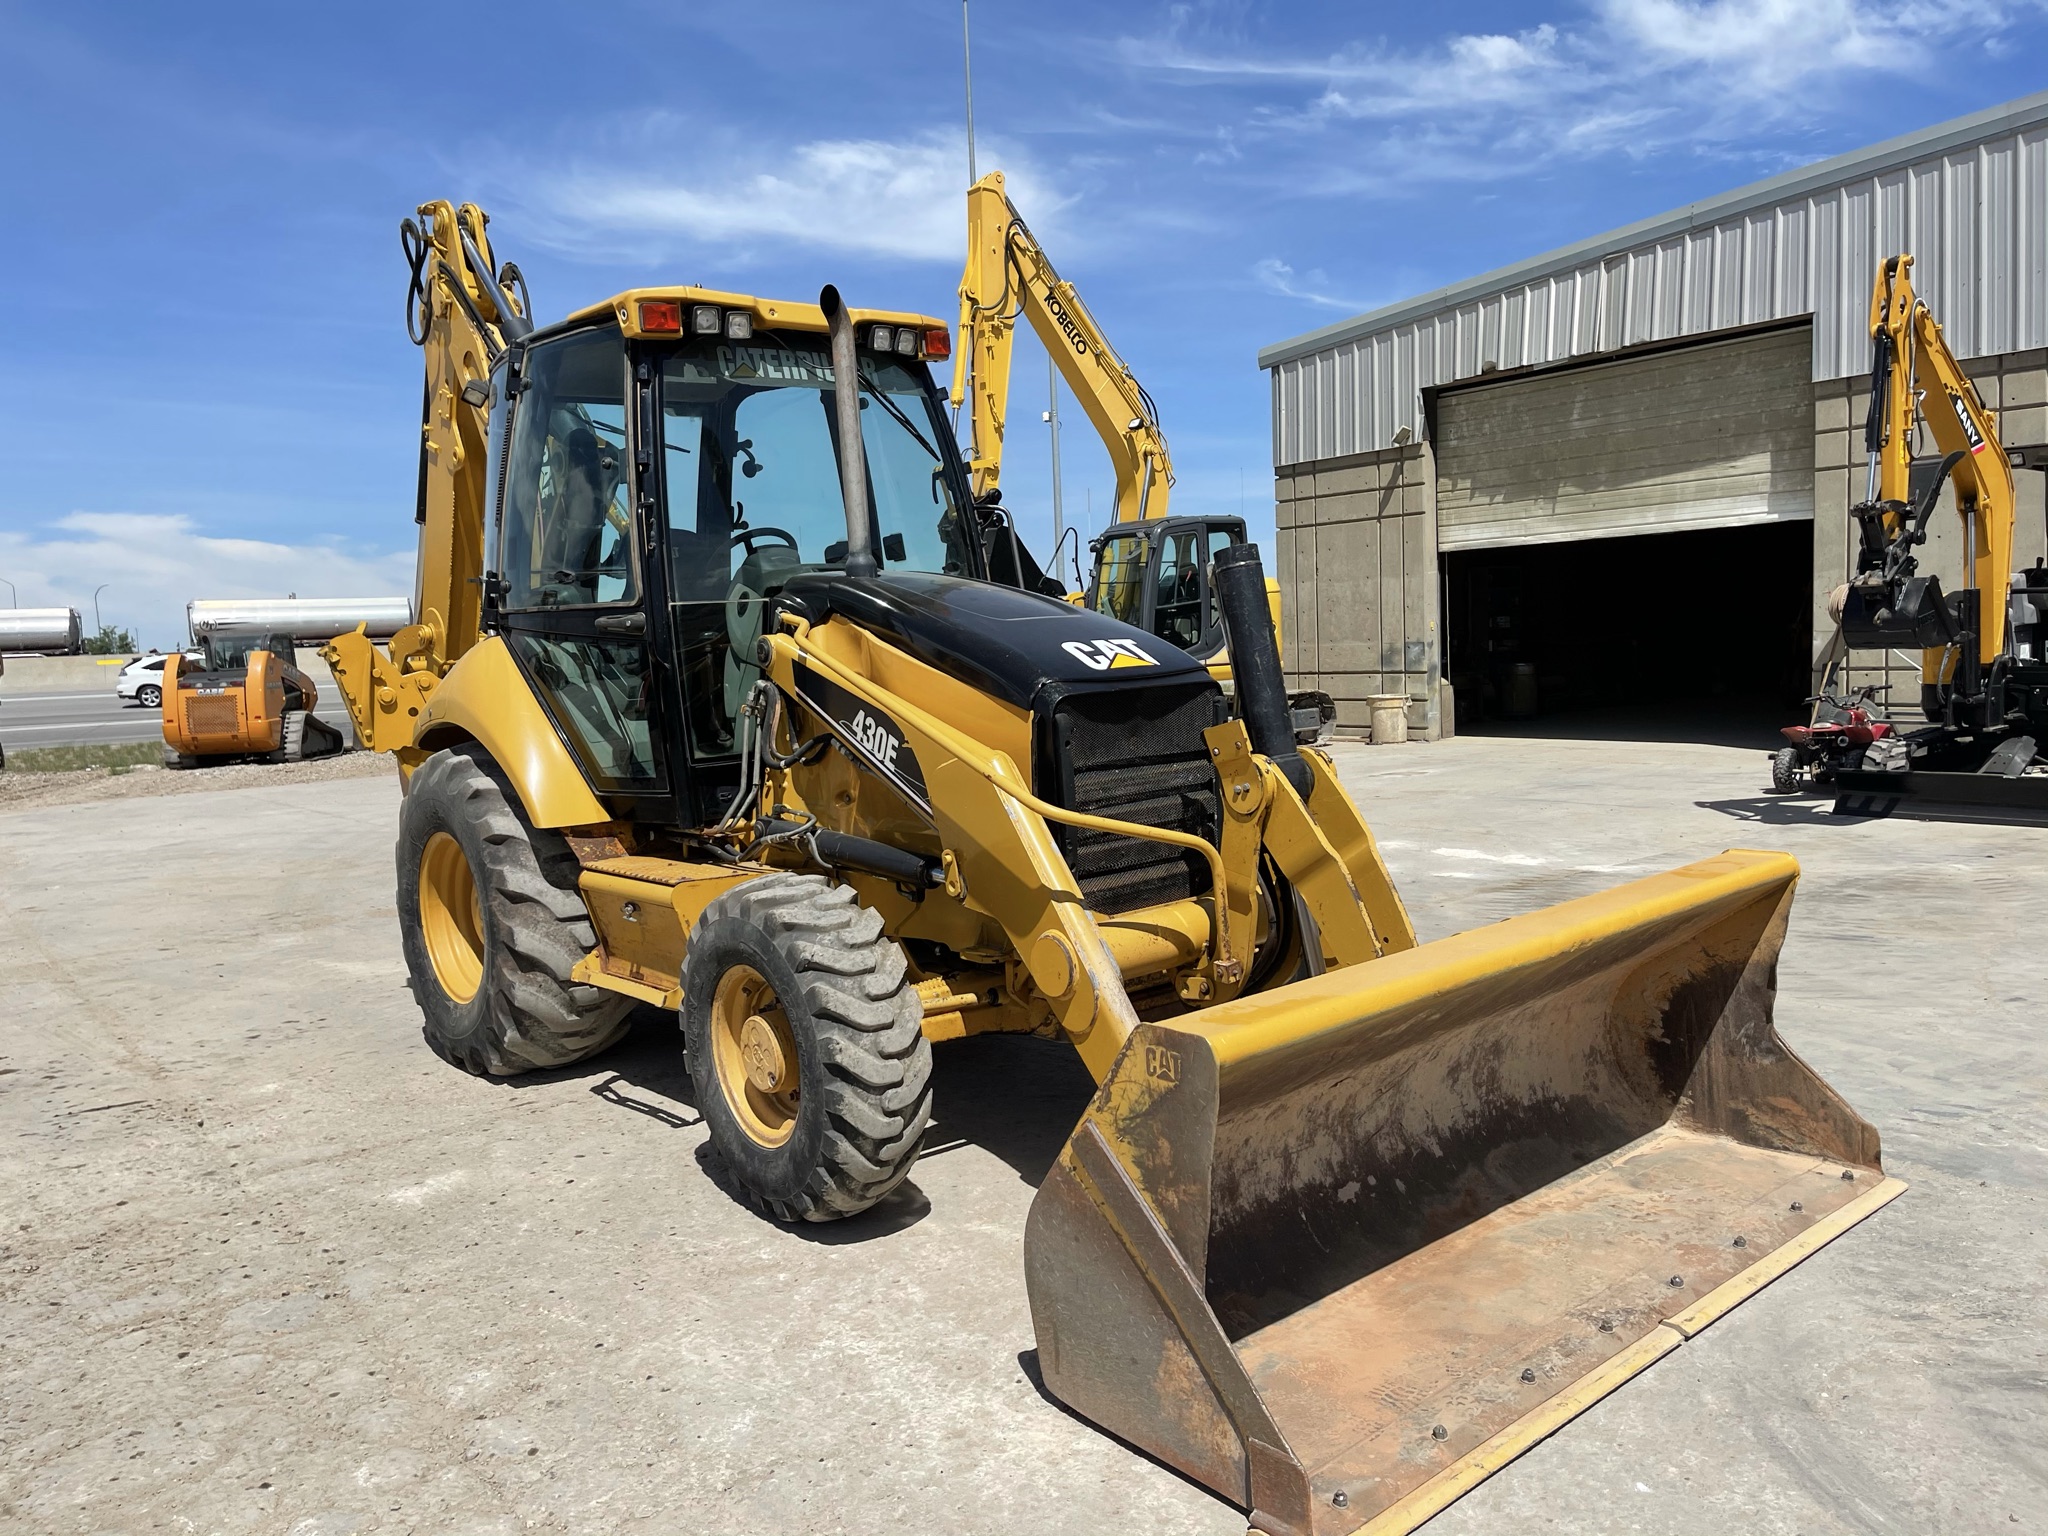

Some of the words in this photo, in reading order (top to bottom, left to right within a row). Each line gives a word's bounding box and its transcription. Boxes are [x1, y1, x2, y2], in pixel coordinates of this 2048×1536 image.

[1044, 291, 1087, 355] KOBELCO
[716, 345, 880, 387] CATERPILR
[1955, 398, 1978, 444] SANY
[1061, 639, 1161, 671] CAT
[852, 709, 899, 772] 430E
[1145, 1046, 1181, 1083] CAT
